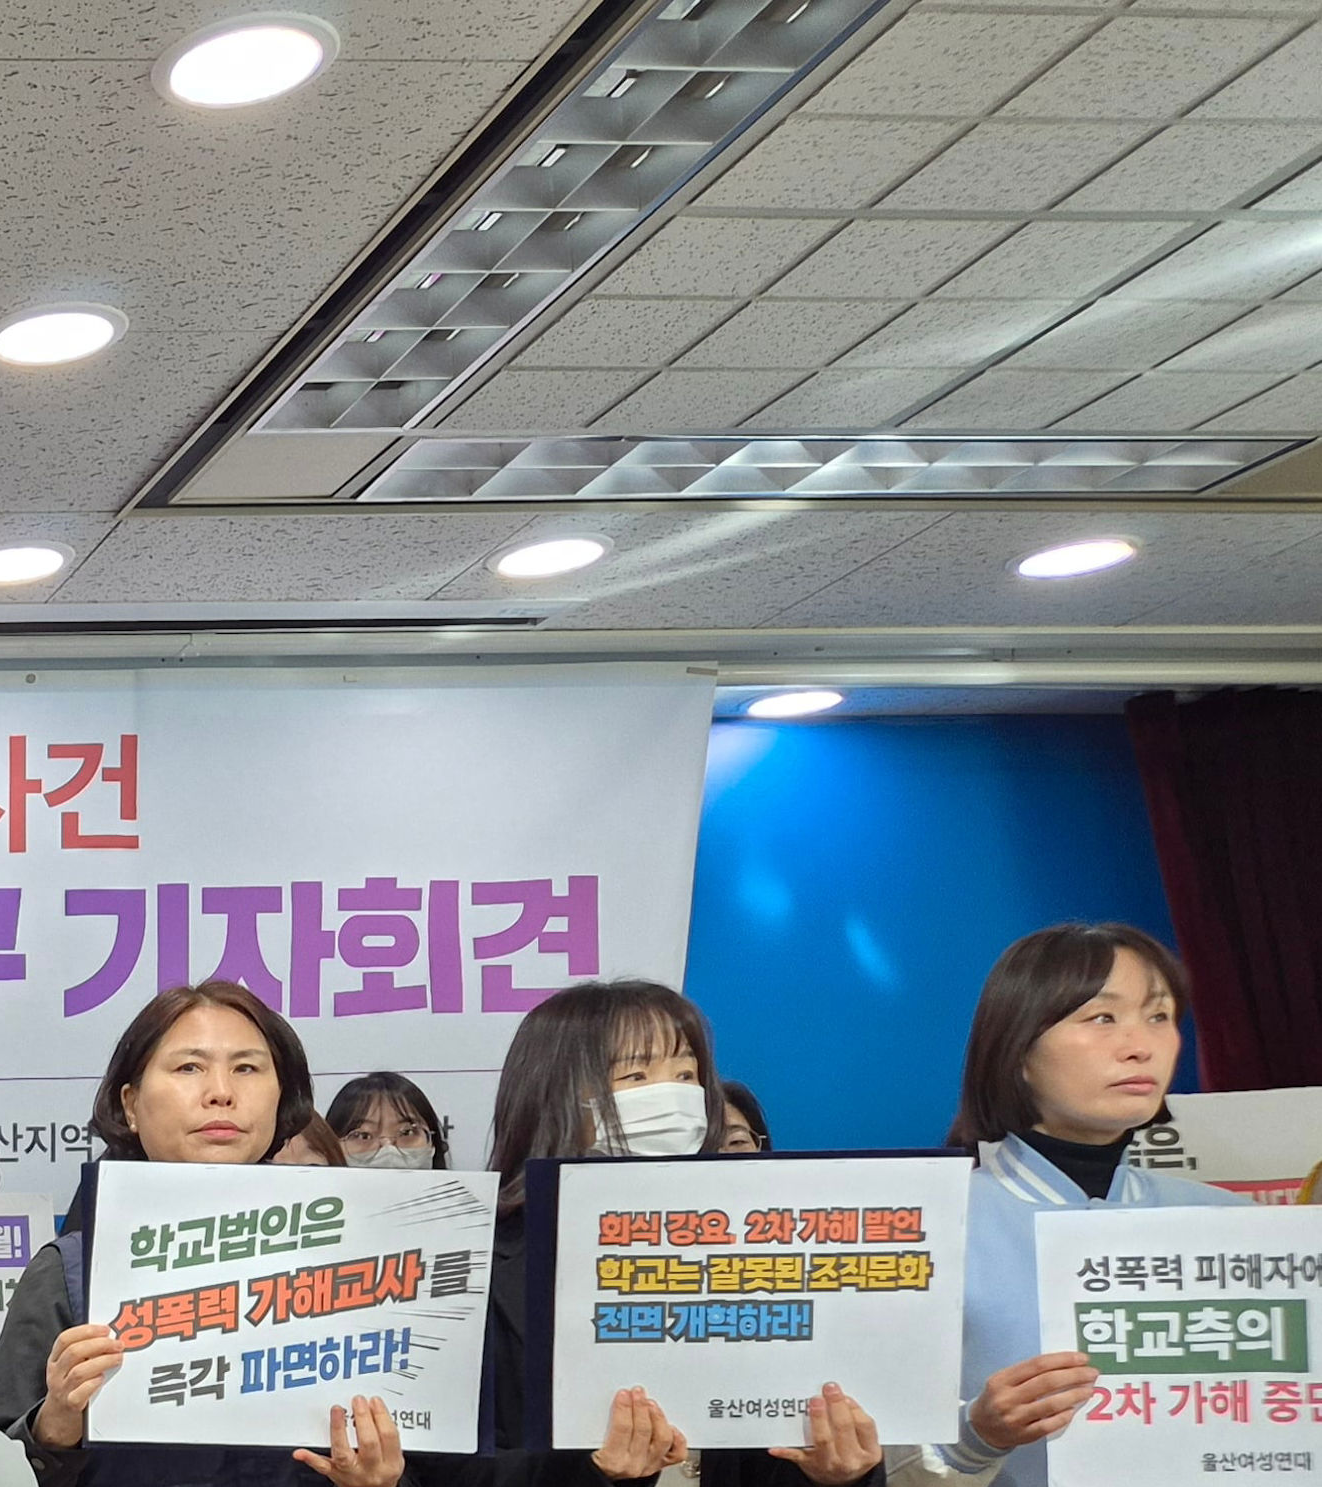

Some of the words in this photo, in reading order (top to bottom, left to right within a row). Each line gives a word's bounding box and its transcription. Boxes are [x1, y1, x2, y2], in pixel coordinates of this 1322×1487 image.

[61, 874, 601, 1021] 기자회견
[129, 1196, 345, 1272] 학교법인은
[598, 1210, 662, 1246] 회식
[744, 1210, 797, 1245] 2차
[797, 1207, 859, 1245] 가해
[596, 1254, 704, 1295] 학교는
[706, 1252, 806, 1295] 잘못된
[807, 1251, 933, 1294] 조직문화
[1076, 1254, 1183, 1292] 성폭력
[109, 1281, 240, 1351] 성폭력
[245, 1248, 425, 1327] 가해교사
[429, 1250, 472, 1299] 를
[591, 1301, 667, 1344] 전면
[667, 1300, 814, 1343] 개혁하라!
[1079, 1306, 1286, 1363] 학교측의
[148, 1355, 230, 1406] 즉각
[240, 1327, 411, 1395] 파면하라!
[1086, 1381, 1156, 1425] 2차
[1168, 1380, 1249, 1424] 가해
[1202, 1452, 1312, 1472] 울산여성연대
